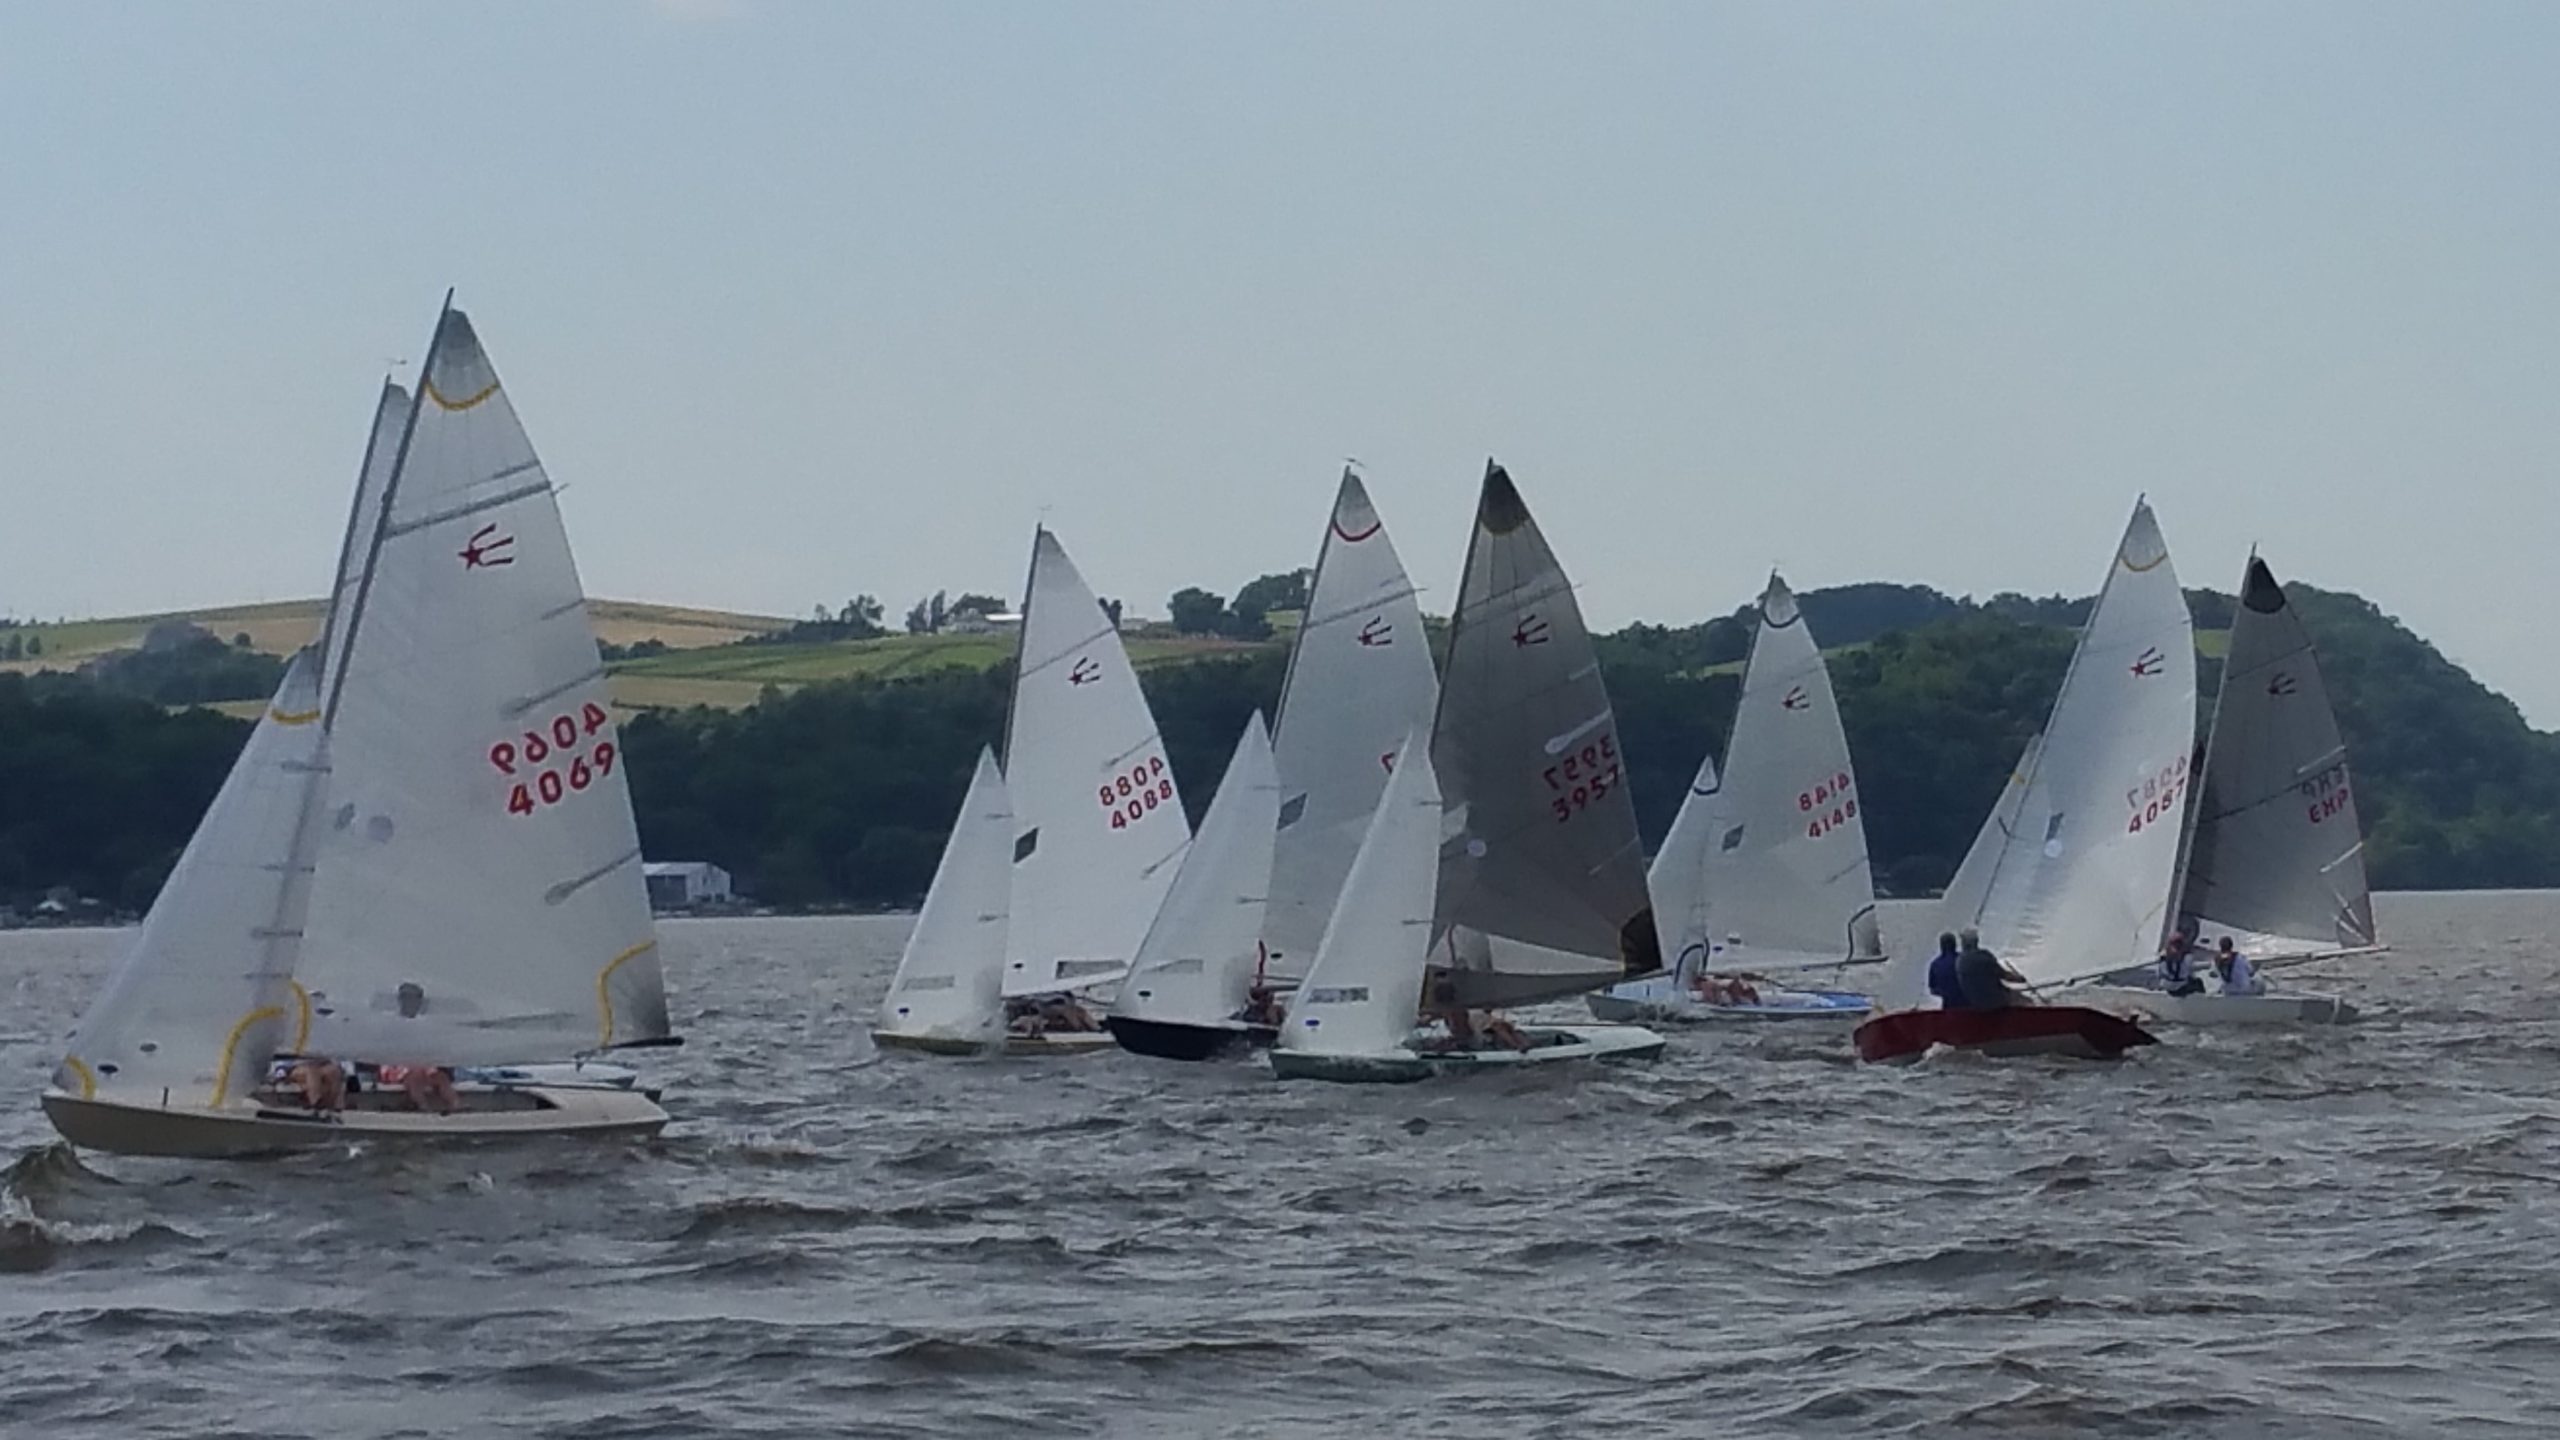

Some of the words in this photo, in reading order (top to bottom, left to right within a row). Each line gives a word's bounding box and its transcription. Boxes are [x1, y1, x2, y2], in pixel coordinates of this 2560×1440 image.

[509, 742, 614, 815] 4069
[1112, 779, 1172, 829] 4088
[1552, 764, 1618, 822] 3957
[2129, 777, 2185, 833] 4087
[1808, 799, 1856, 838] 4148
